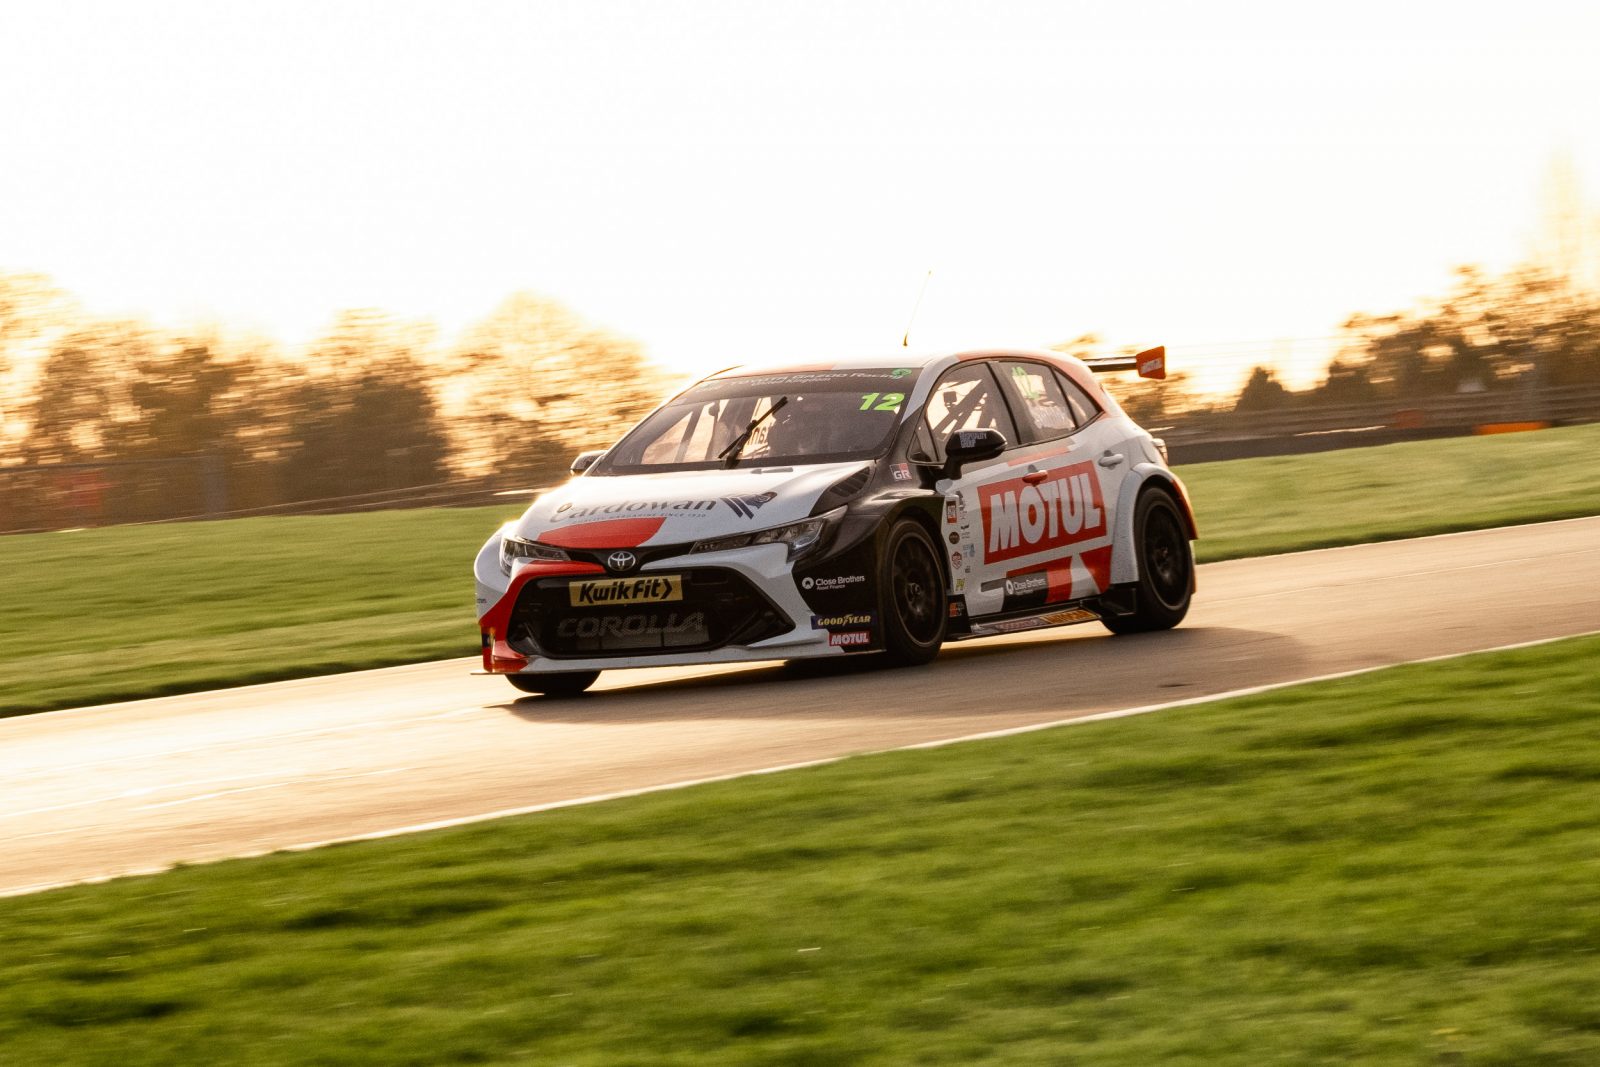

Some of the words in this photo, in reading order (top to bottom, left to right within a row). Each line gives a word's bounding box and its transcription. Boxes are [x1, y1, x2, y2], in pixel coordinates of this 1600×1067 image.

[860, 392, 905, 411] 12
[893, 470, 912, 480] GR
[989, 473, 1101, 553] MOTUL
[815, 578, 837, 586] Close
[838, 576, 865, 584] Brothers
[557, 613, 705, 637] COROLLA
[817, 614, 871, 626] GOODYEAR
[831, 633, 869, 645] MOTUL
